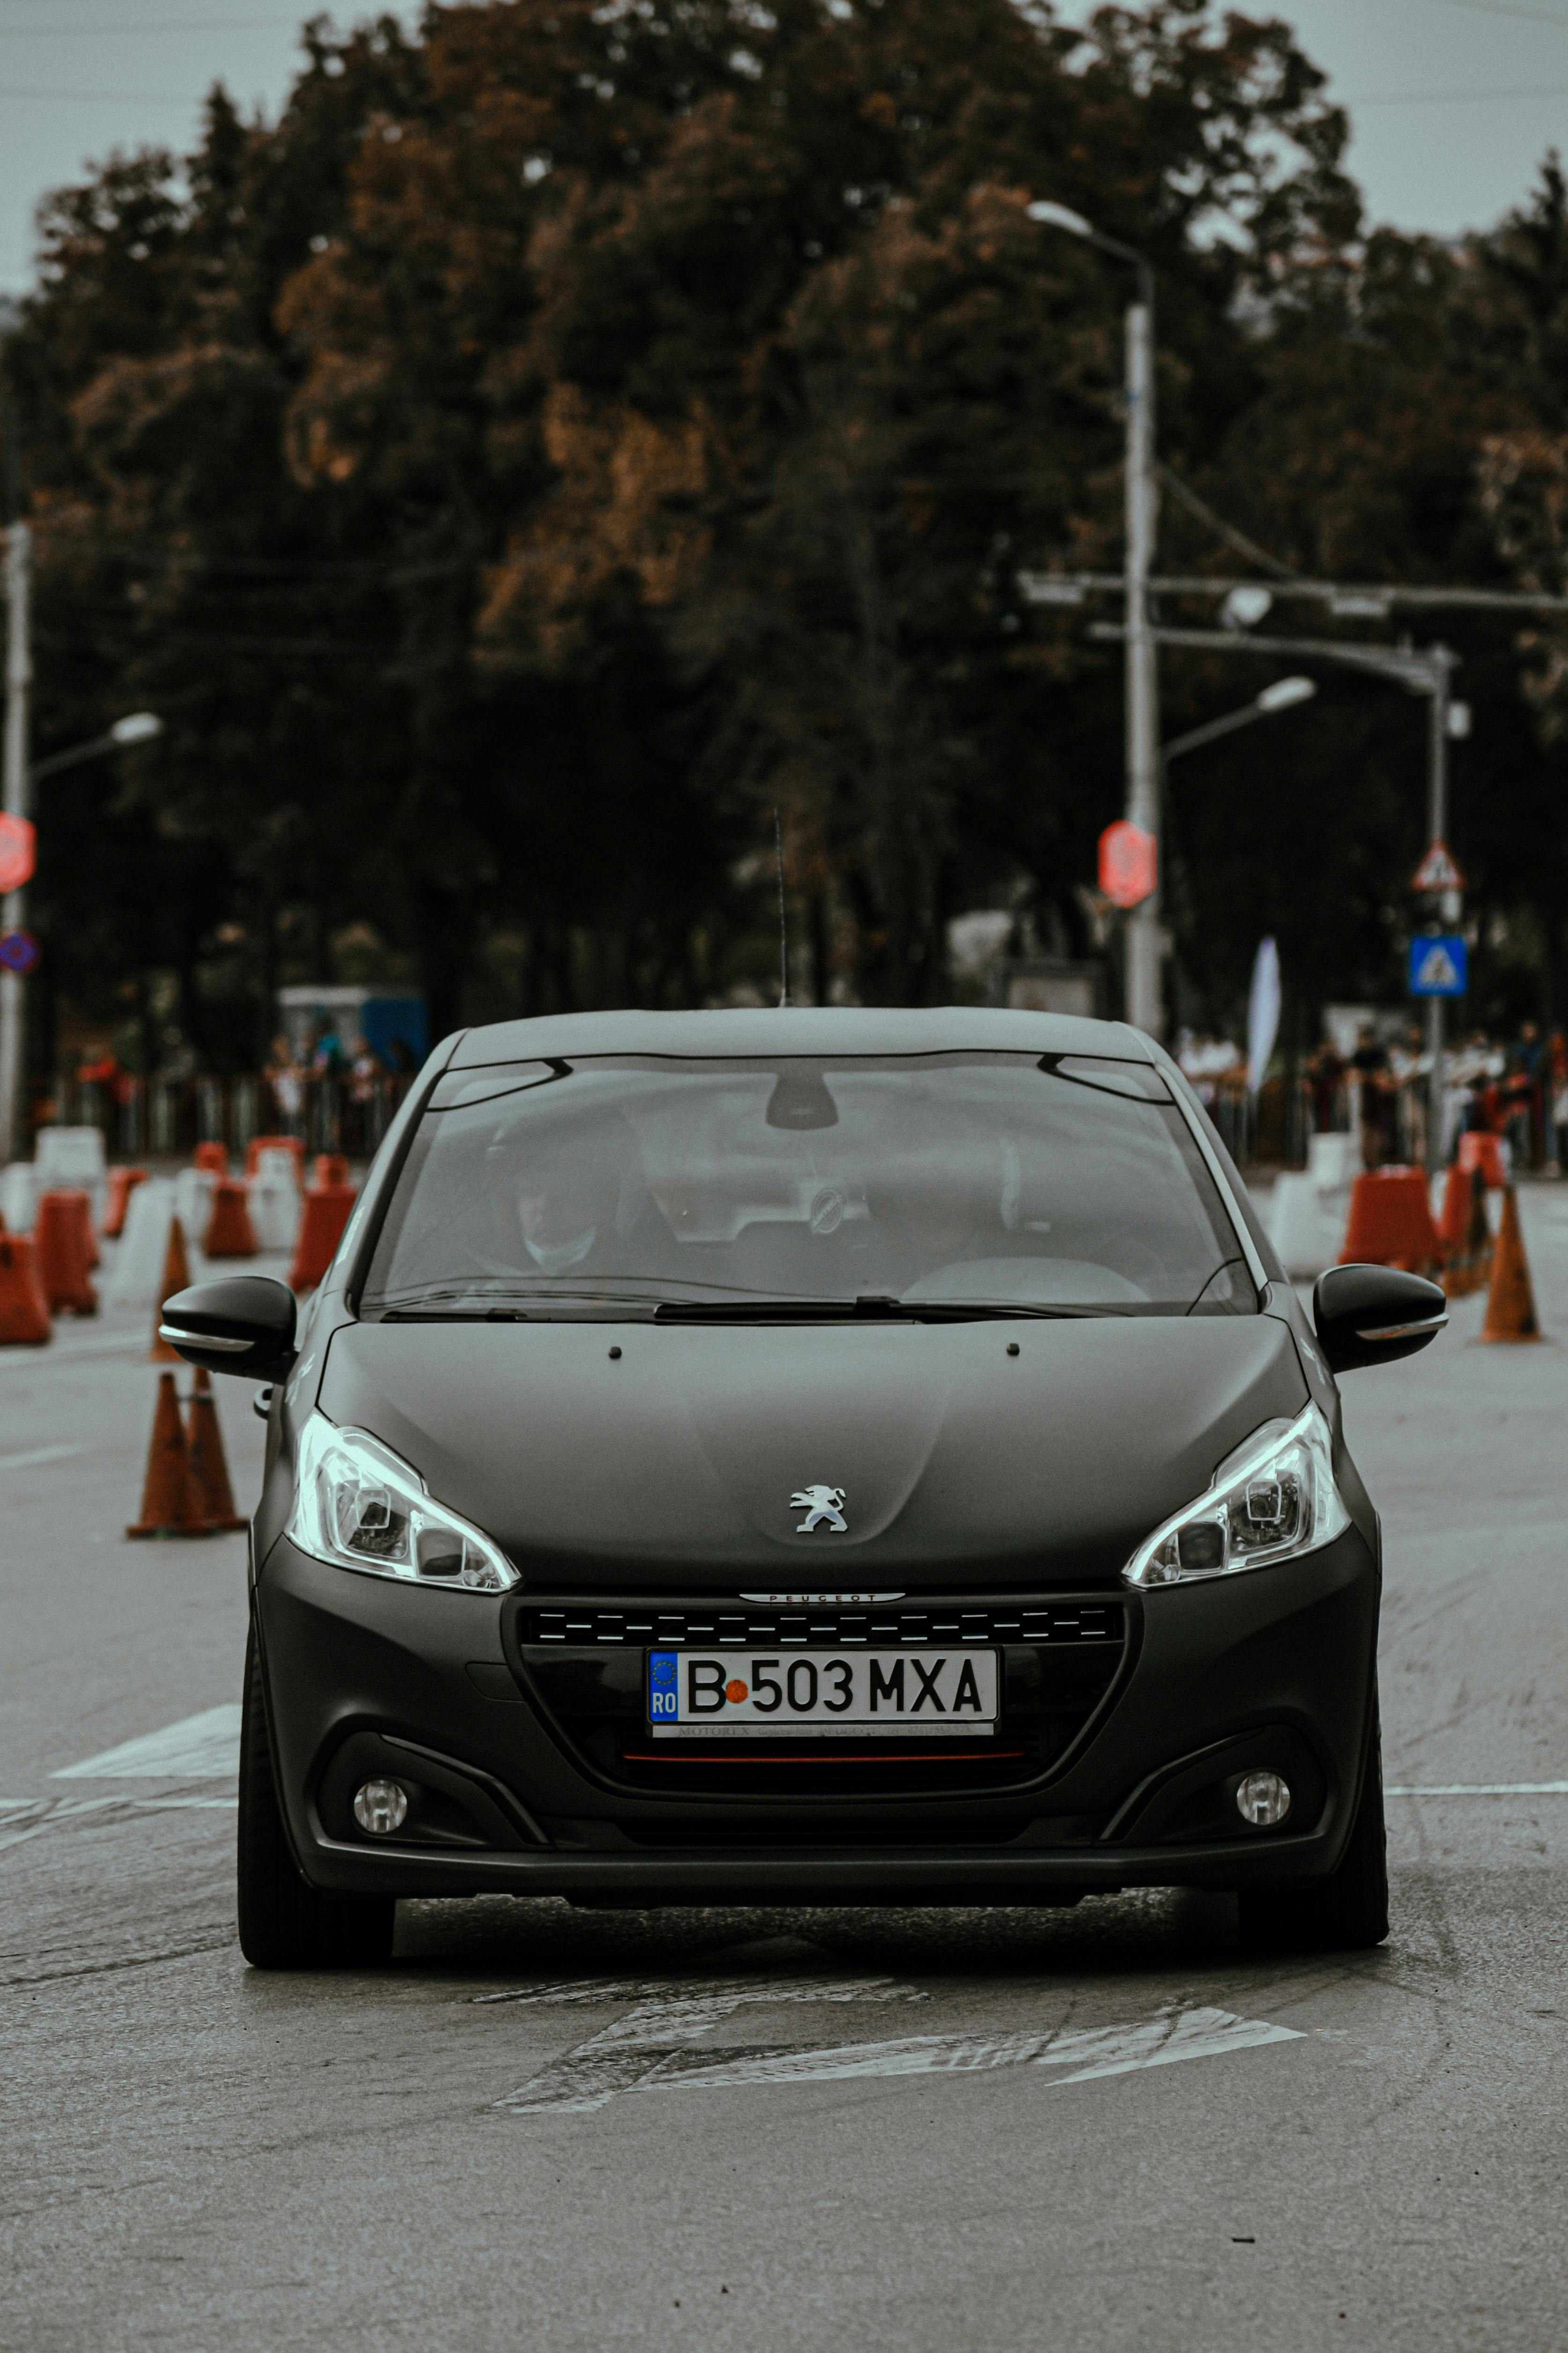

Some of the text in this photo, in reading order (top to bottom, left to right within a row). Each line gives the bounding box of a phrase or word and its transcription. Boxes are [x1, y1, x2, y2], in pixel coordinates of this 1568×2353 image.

[653, 1692, 676, 1714] RO
[688, 1658, 983, 1713] B 503 MXA
